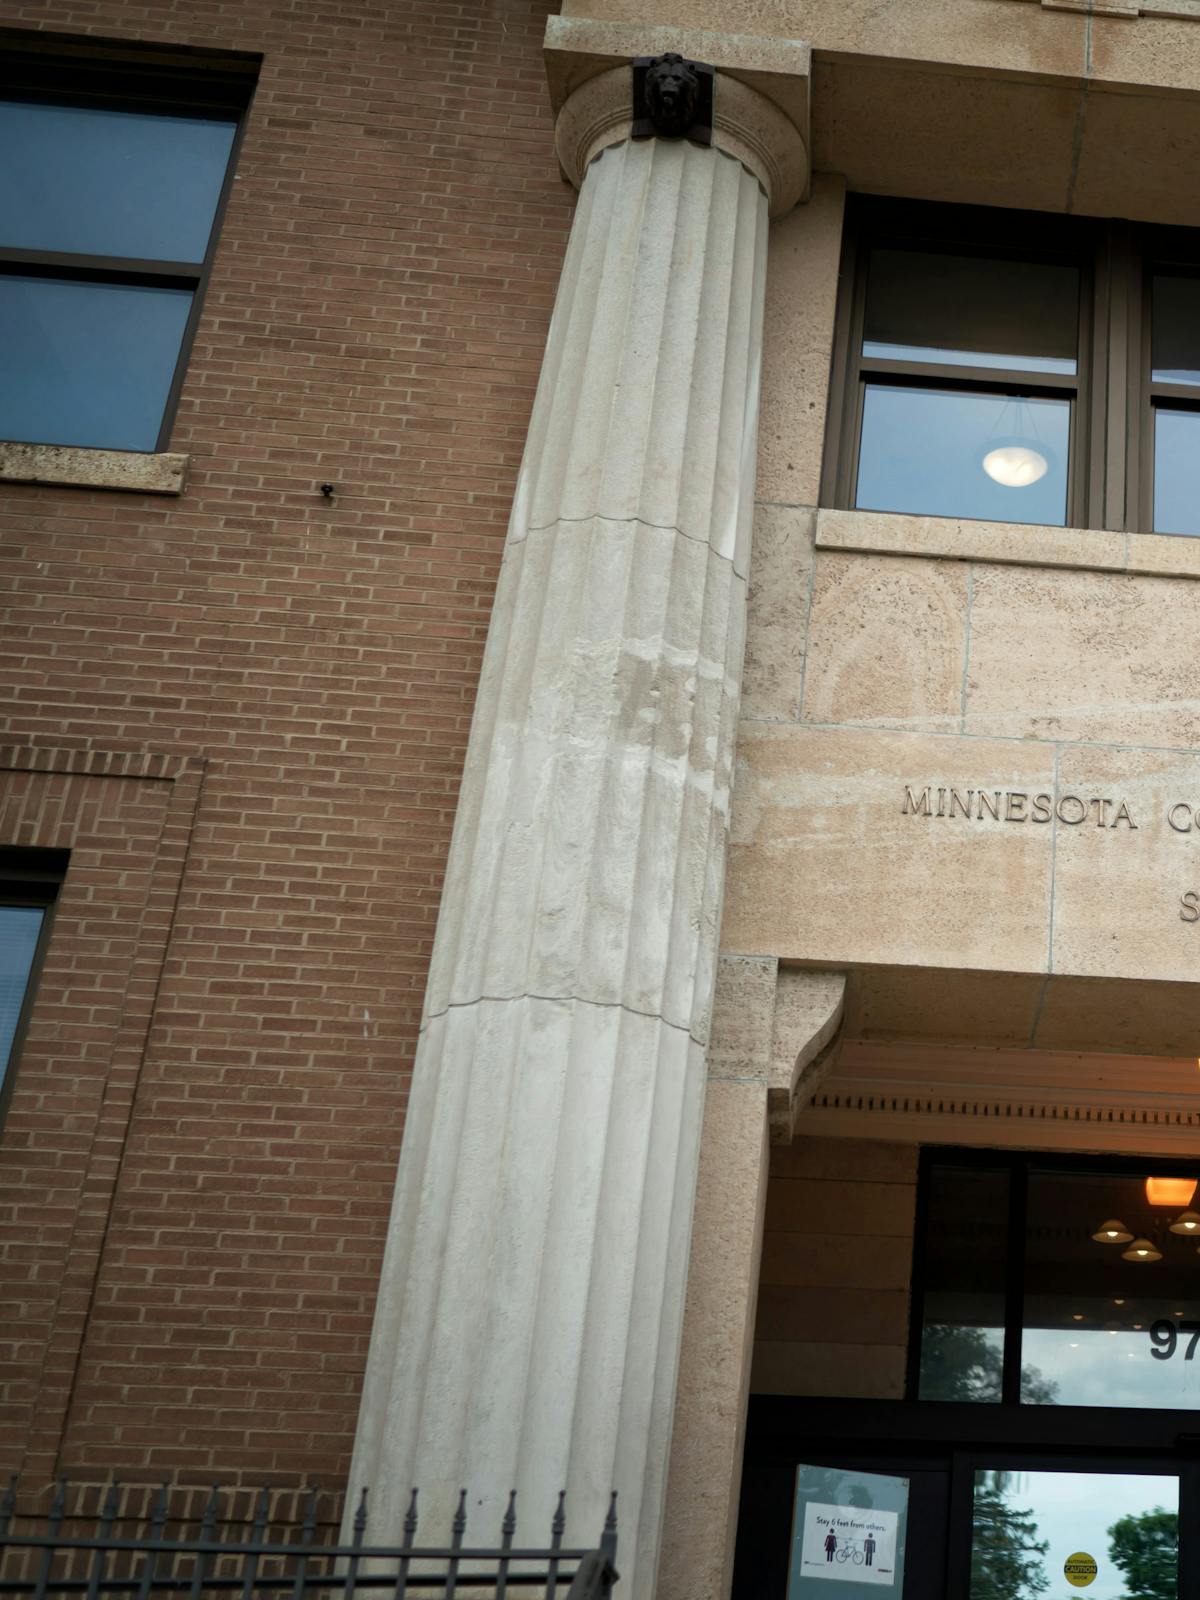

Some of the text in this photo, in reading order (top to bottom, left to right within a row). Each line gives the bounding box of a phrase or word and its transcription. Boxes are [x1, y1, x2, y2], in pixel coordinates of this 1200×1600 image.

[902, 784, 1138, 829] MINNESOTA
[816, 1516, 830, 1527] Stay
[831, 1518, 836, 1526] 6
[837, 1518, 849, 1527] feet
[850, 1519, 865, 1529] from
